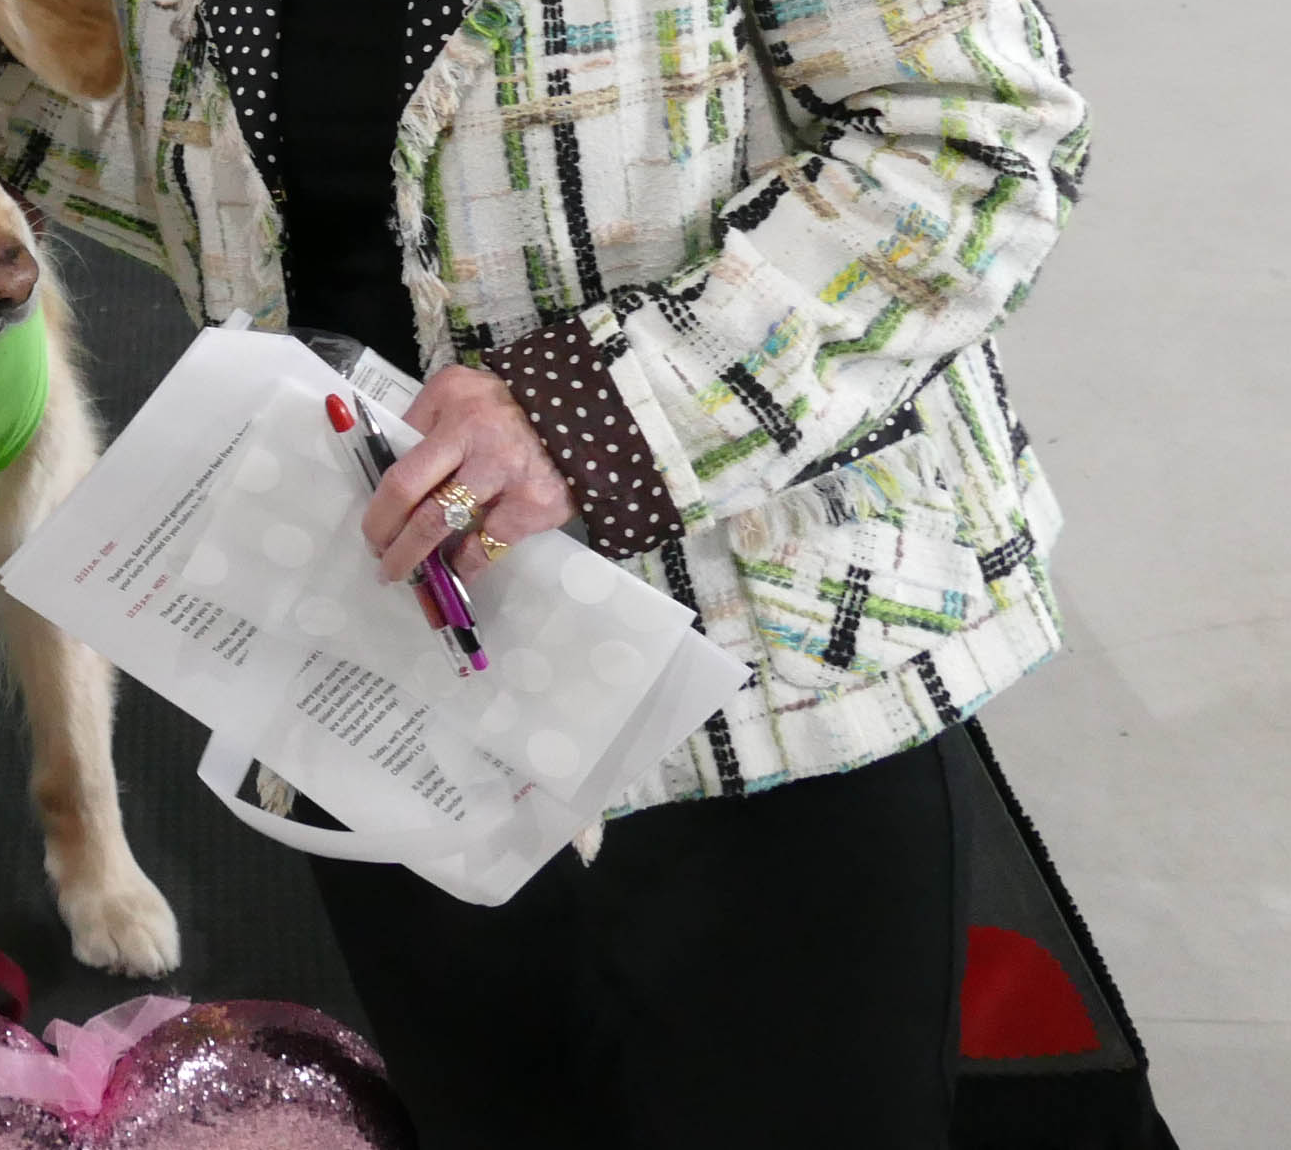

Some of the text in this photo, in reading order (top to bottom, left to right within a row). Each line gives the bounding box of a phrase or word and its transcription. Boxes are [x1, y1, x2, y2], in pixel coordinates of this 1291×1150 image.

[107, 567, 125, 583] Thank
[158, 515, 171, 527] and
[195, 468, 215, 489] please
[210, 456, 225, 470] feel
[220, 444, 235, 458] free
[118, 577, 132, 591] your
[129, 564, 145, 579] lunch
[142, 540, 166, 566] provided
[168, 524, 181, 536] you
[160, 601, 177, 618] Thank
[170, 612, 185, 625] Now
[182, 601, 196, 613] that
[188, 616, 199, 626] ask
[222, 636, 247, 660] Colorado
[296, 693, 315, 709] Every
[324, 666, 341, 682] more
[306, 702, 323, 716] from
[320, 695, 329, 703] all
[327, 683, 341, 696] over
[338, 674, 351, 685] the
[333, 689, 354, 708] babies
[327, 721, 340, 732] are
[337, 698, 364, 723] surviving
[360, 685, 376, 700] even
[337, 723, 357, 739] living
[352, 708, 370, 726] proof
[372, 694, 386, 705] the
[400, 716, 418, 732] meet
[348, 722, 375, 747] Colorado
[372, 710, 388, 724] each
[380, 734, 417, 769] represent the
[390, 750, 419, 776] Children's
